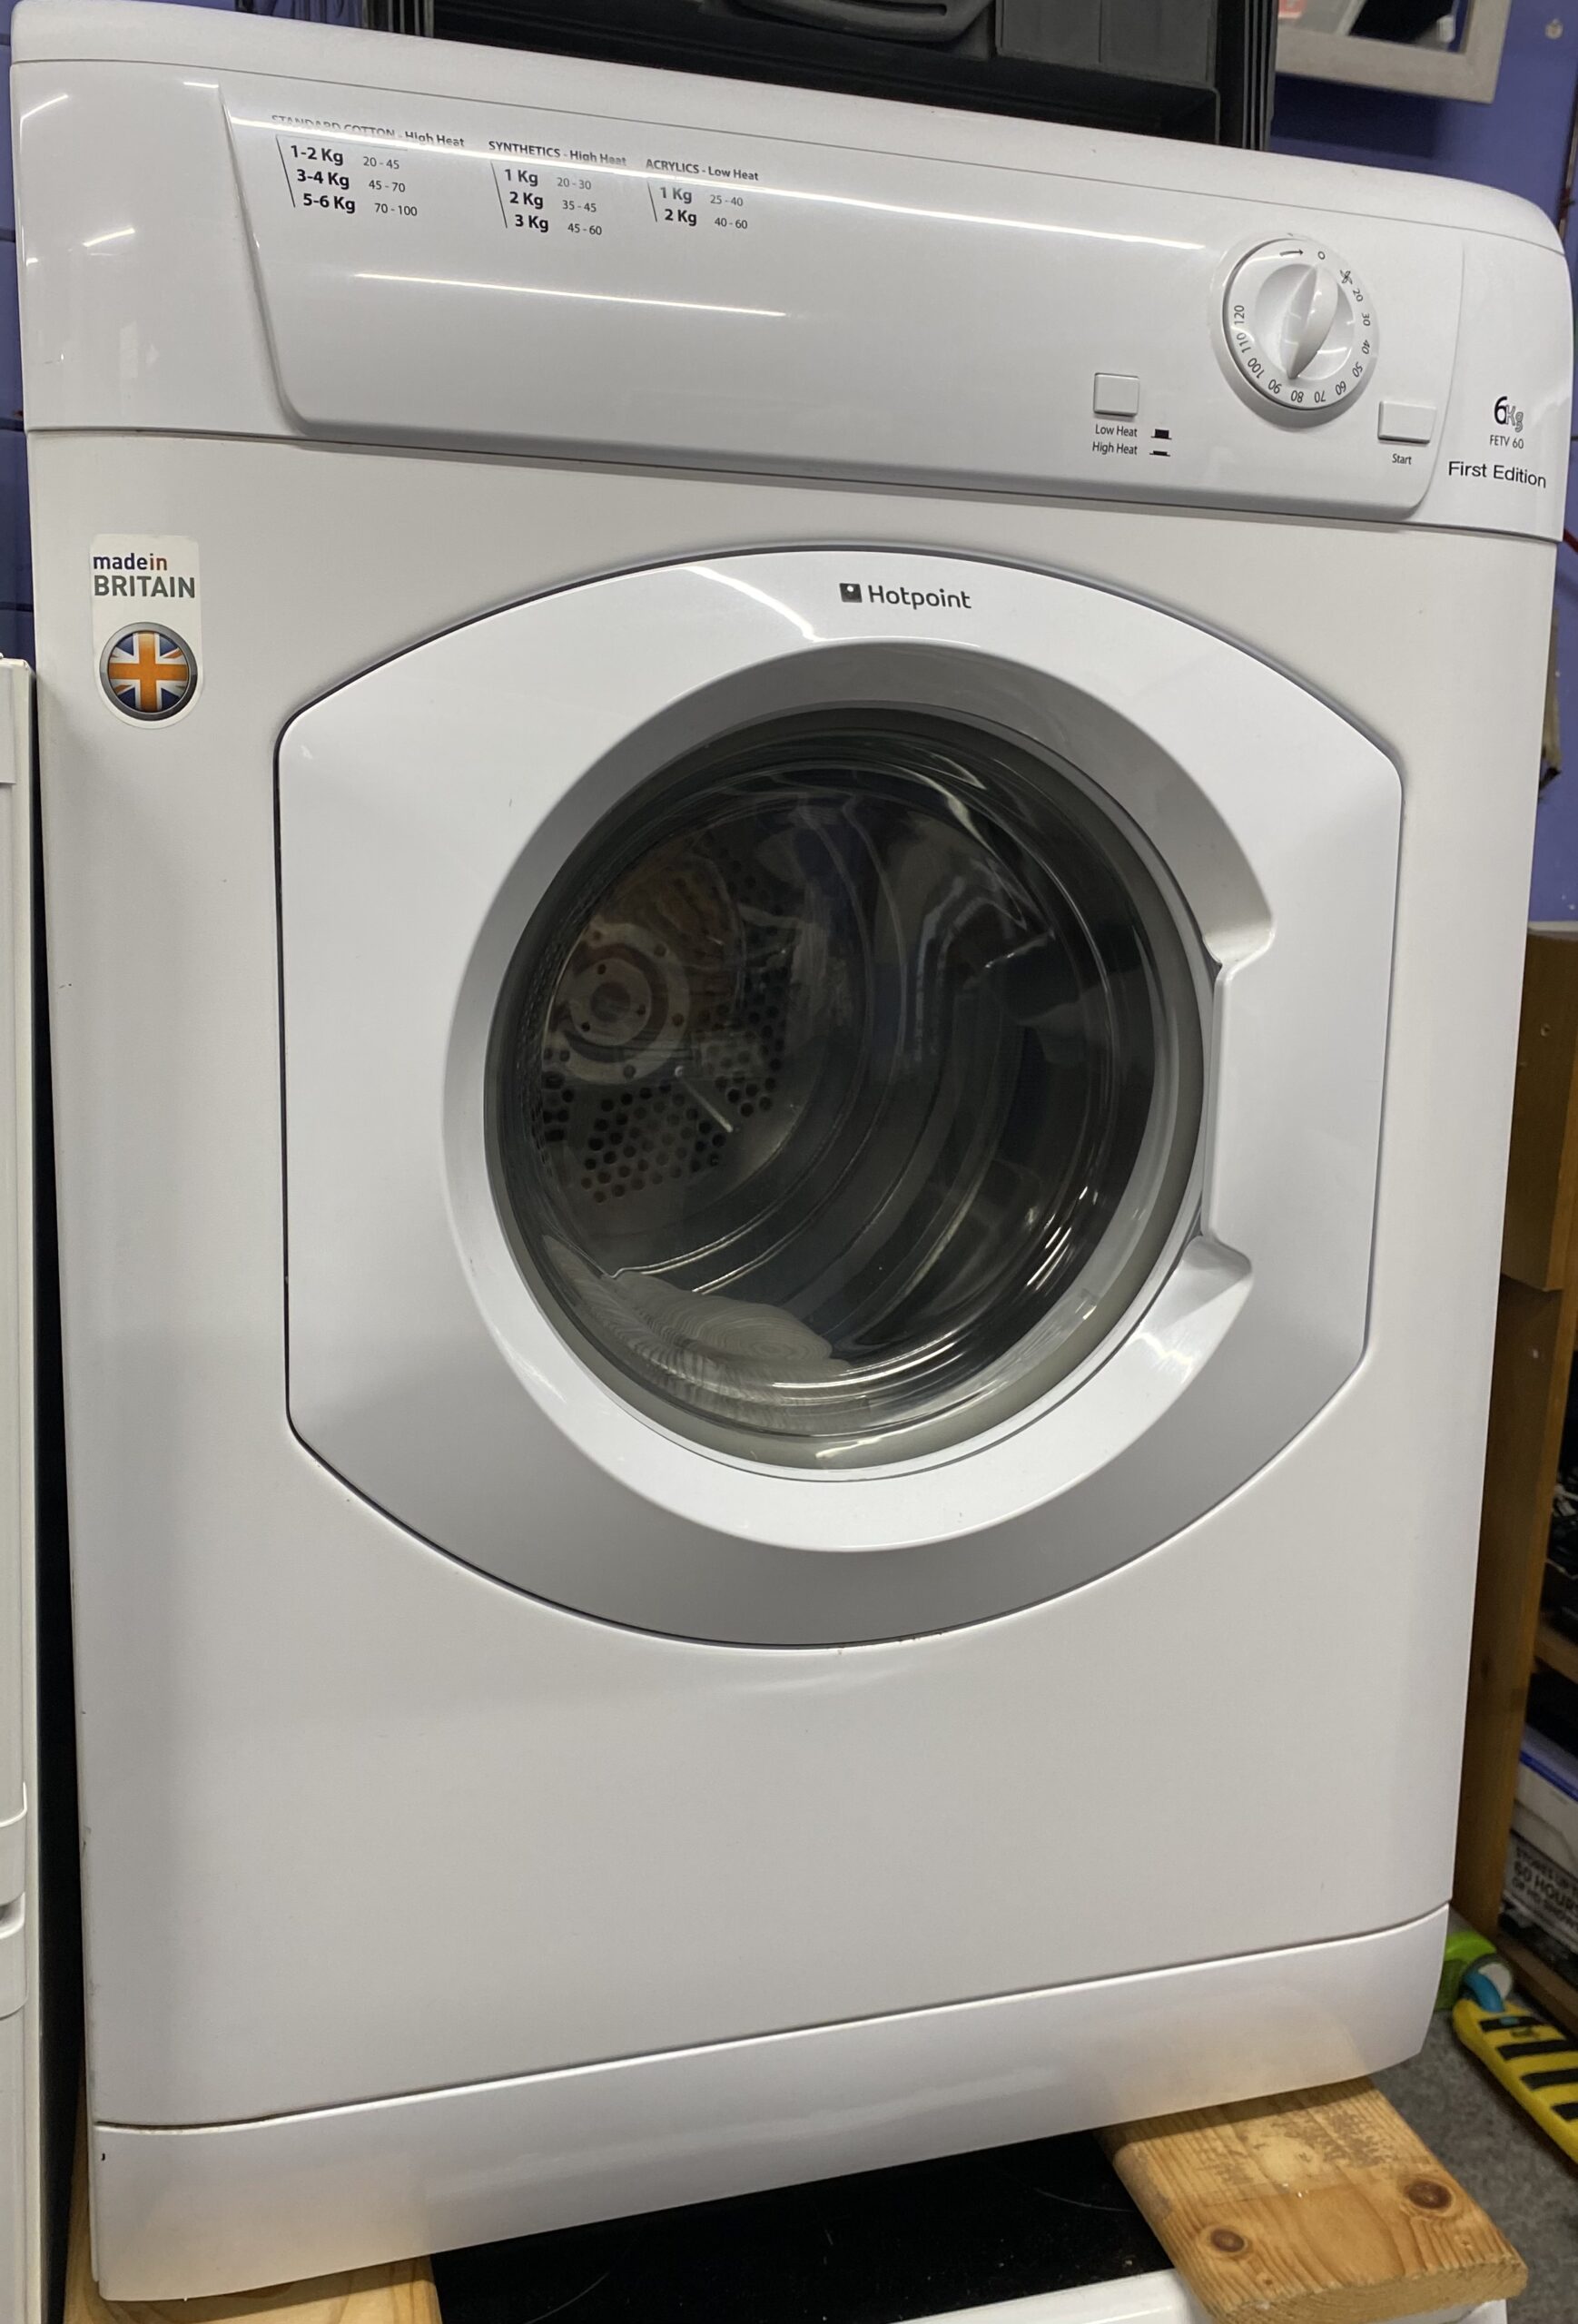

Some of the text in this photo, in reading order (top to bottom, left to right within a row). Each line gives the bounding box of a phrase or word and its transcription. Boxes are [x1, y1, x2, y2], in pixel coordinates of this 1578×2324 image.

[405, 131, 433, 144] High
[437, 135, 465, 148] Heat
[291, 145, 318, 160] 1-2
[321, 149, 343, 166] Kg
[363, 156, 377, 167] 20
[387, 159, 399, 170] 45
[488, 141, 560, 158] SYNTHETICS
[570, 150, 597, 164] High
[600, 153, 626, 166] Heat
[505, 169, 512, 181] 1
[518, 170, 538, 187] Kg
[557, 177, 570, 188] 20
[579, 180, 592, 191] 30
[646, 158, 700, 174] ACRYLICS
[708, 165, 731, 179] Low
[734, 169, 759, 182] Heat
[298, 169, 324, 184] 3-4
[328, 172, 350, 190] Kg
[369, 180, 382, 191] 45
[392, 182, 406, 192] 70
[303, 193, 330, 208] 5-6
[334, 196, 355, 214] Kg
[375, 203, 388, 214] 70
[399, 205, 418, 217] 100
[510, 192, 519, 204] 2
[523, 192, 544, 210] Kg
[562, 200, 576, 211] 35
[584, 202, 597, 212] 45
[660, 187, 666, 199] 1
[673, 187, 693, 204] Kg
[710, 194, 723, 205] 25
[731, 196, 744, 207] 40
[516, 214, 524, 227] 3
[528, 215, 549, 233] Kg
[567, 222, 580, 233] 45
[589, 225, 602, 235] 60
[665, 209, 674, 221] 2
[677, 210, 697, 227] Kg
[715, 218, 727, 228] 40
[735, 220, 748, 230] 60
[1317, 251, 1326, 260] 0
[1353, 290, 1363, 302] 20
[1234, 305, 1245, 325] 120
[1362, 312, 1371, 326] 30
[1237, 332, 1251, 353] 110
[1362, 340, 1370, 354] 40
[1248, 358, 1265, 379] 100
[1353, 361, 1363, 378] 50
[1268, 379, 1282, 394] 90
[1291, 390, 1304, 403] 80
[1315, 390, 1326, 403] 70
[1336, 381, 1346, 395] 60
[1095, 424, 1138, 438] Low Heat
[1092, 441, 1138, 455] High Heat
[1490, 435, 1524, 449] FETV 60
[1392, 454, 1412, 465] Start
[1449, 461, 1546, 488] First Edition
[94, 575, 195, 598] BRITAIN
[868, 585, 971, 610] Hotpoint
